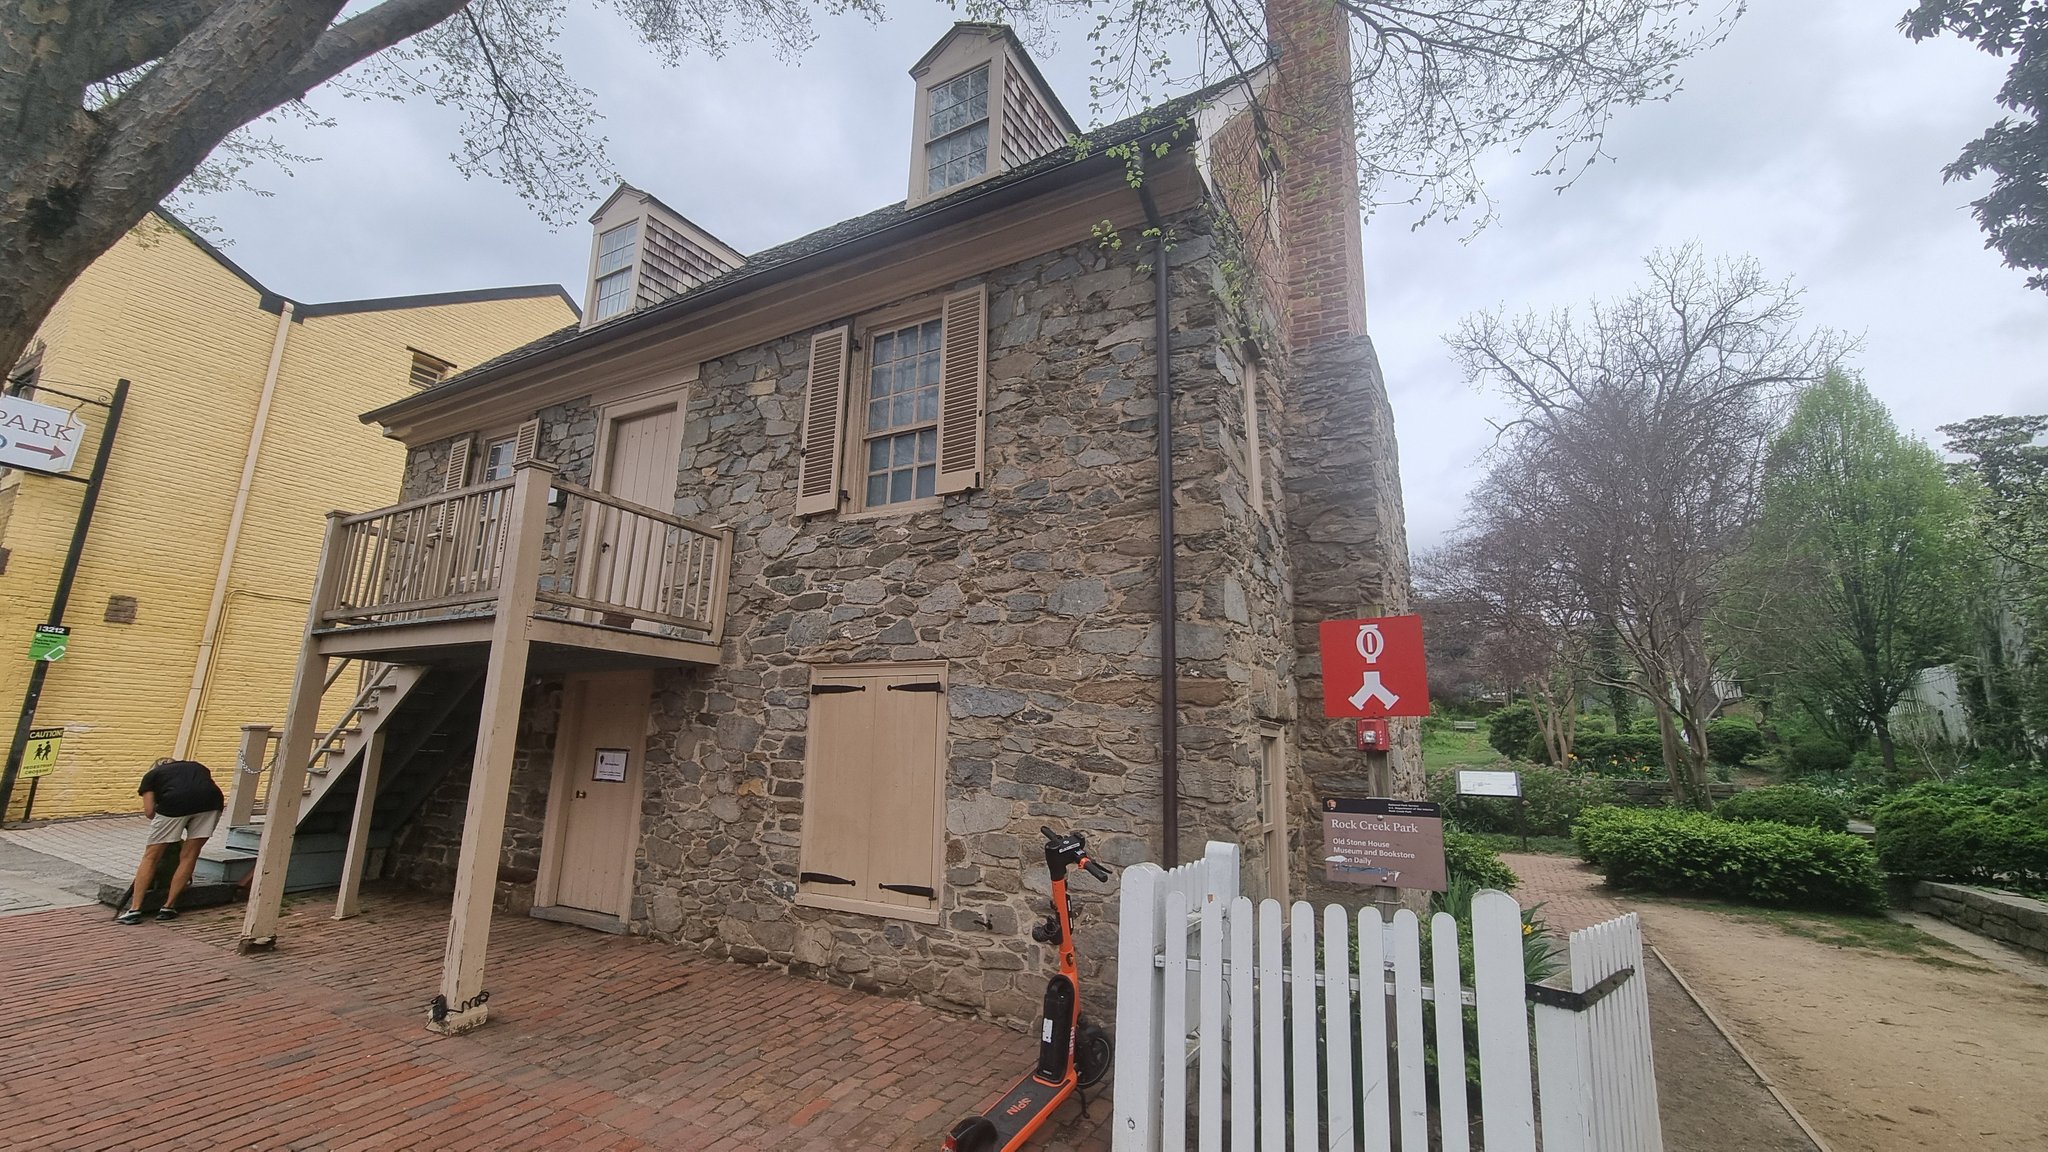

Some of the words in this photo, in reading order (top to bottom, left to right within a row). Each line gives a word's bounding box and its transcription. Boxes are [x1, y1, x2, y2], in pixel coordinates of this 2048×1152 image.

[42, 626, 65, 634] 3212
[1331, 819, 1357, 830] Rock
[1360, 820, 1391, 832] Creek
[1393, 822, 1418, 832] Park
[1346, 838, 1366, 846] Stone
[1368, 840, 1390, 848] House
[1334, 846, 1362, 855] Museum
[1379, 850, 1415, 858] Bookstore
[1354, 857, 1372, 866] Daily
[1006, 1098, 1032, 1116] SPIN
